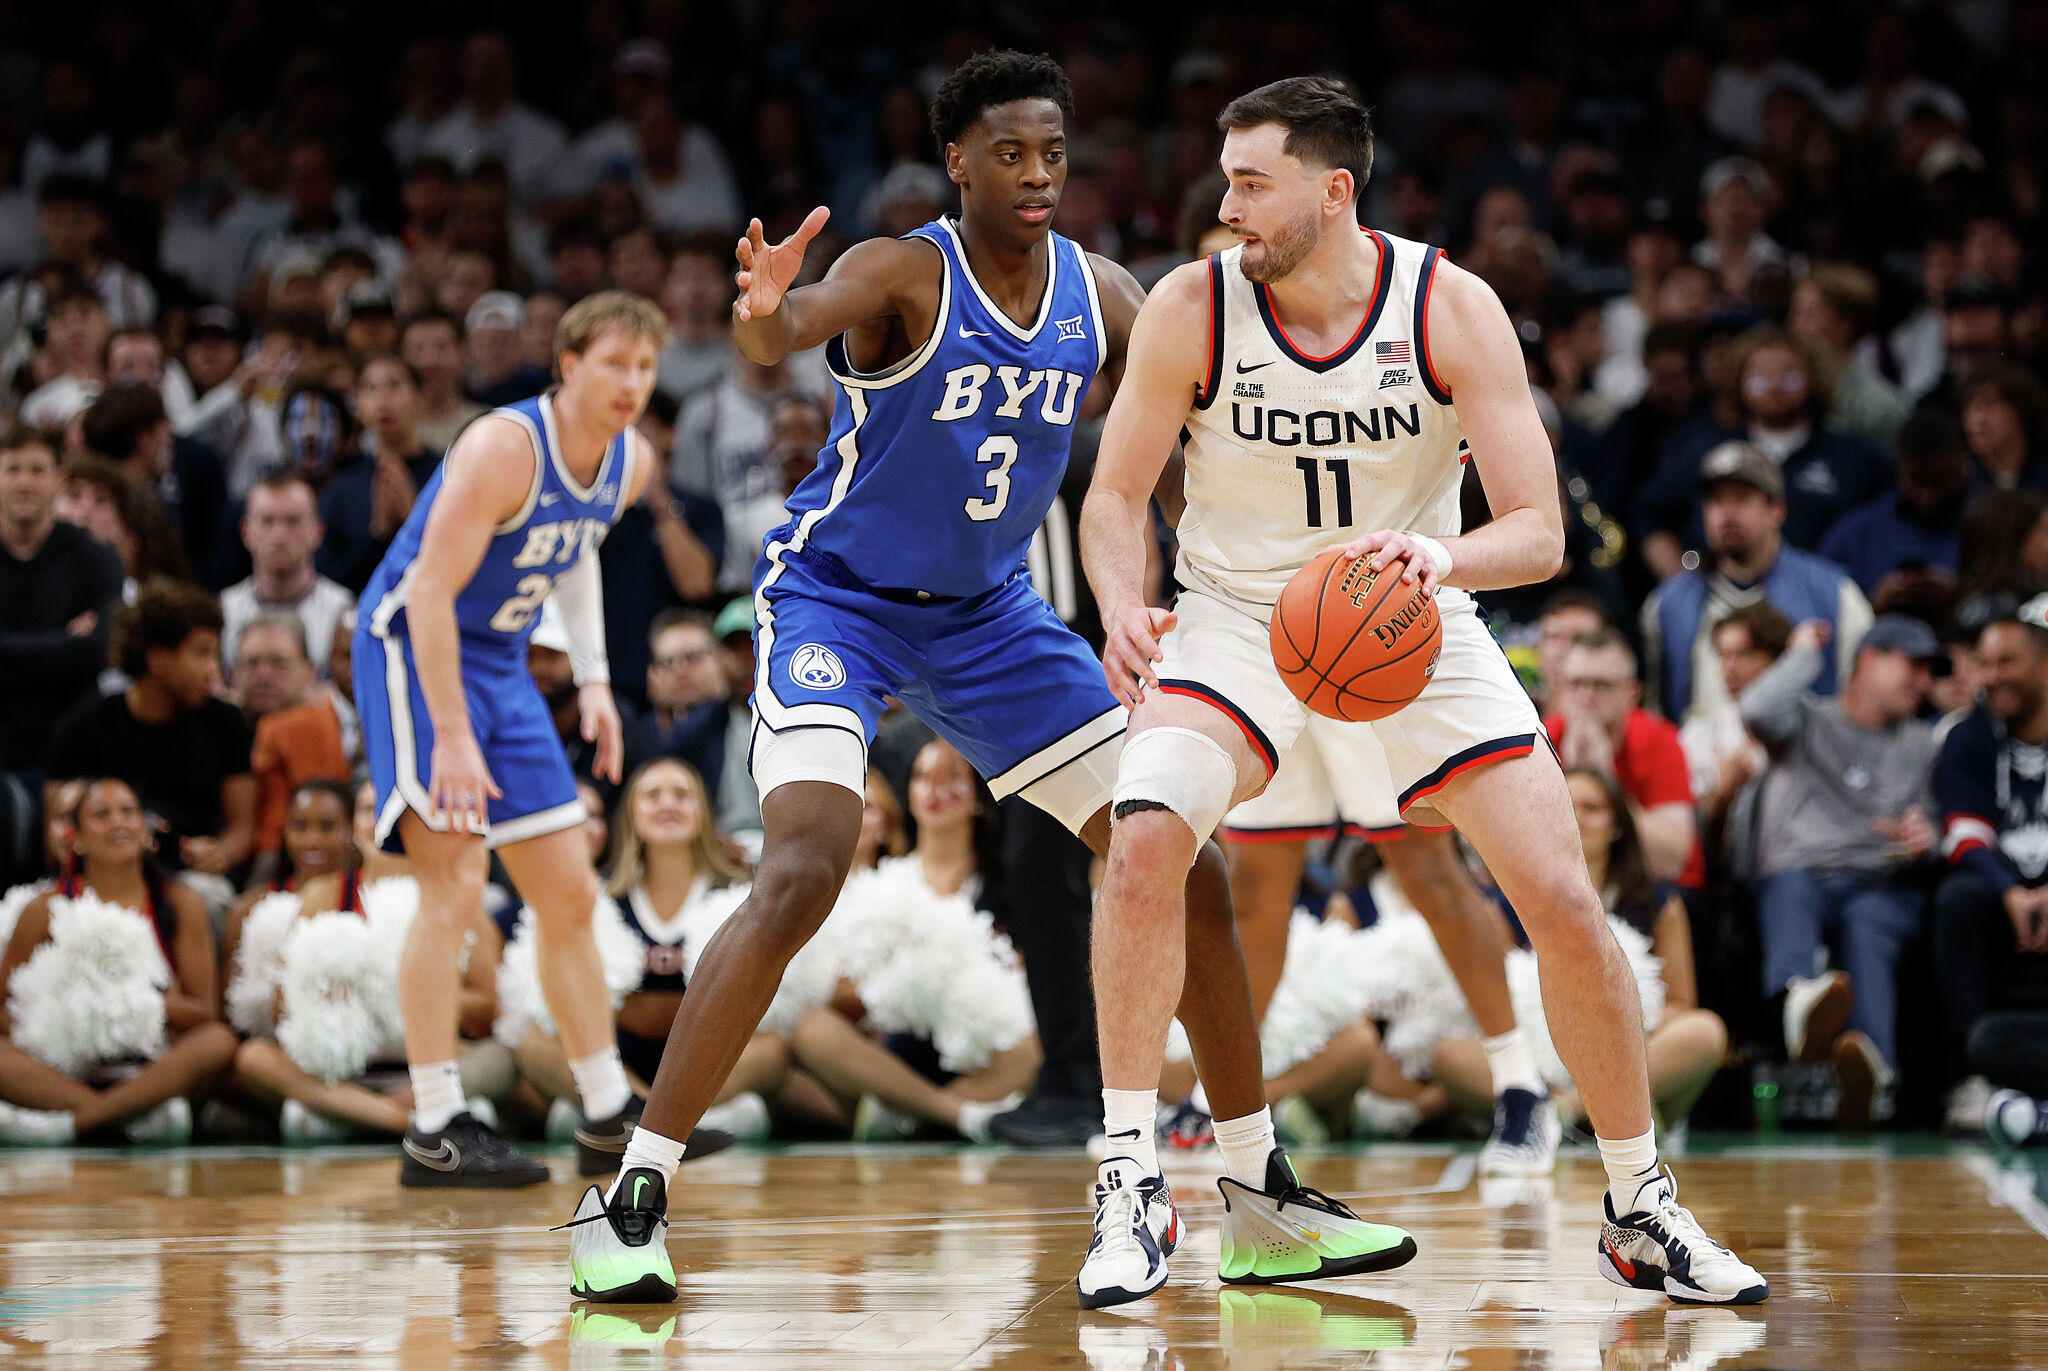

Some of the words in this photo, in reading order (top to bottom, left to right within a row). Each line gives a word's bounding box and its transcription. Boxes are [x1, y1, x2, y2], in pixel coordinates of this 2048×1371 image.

[931, 363, 1084, 426] BYU
[1232, 389, 1265, 398] CHANGE
[1235, 382, 1246, 390] BE
[1249, 383, 1264, 391] THE
[1380, 376, 1414, 385] EAST
[1383, 369, 1407, 378] BIG
[1231, 402, 1421, 446] UCONN
[964, 434, 1019, 522] 3
[1296, 455, 1353, 528] 11
[1373, 588, 1430, 650] LDING
